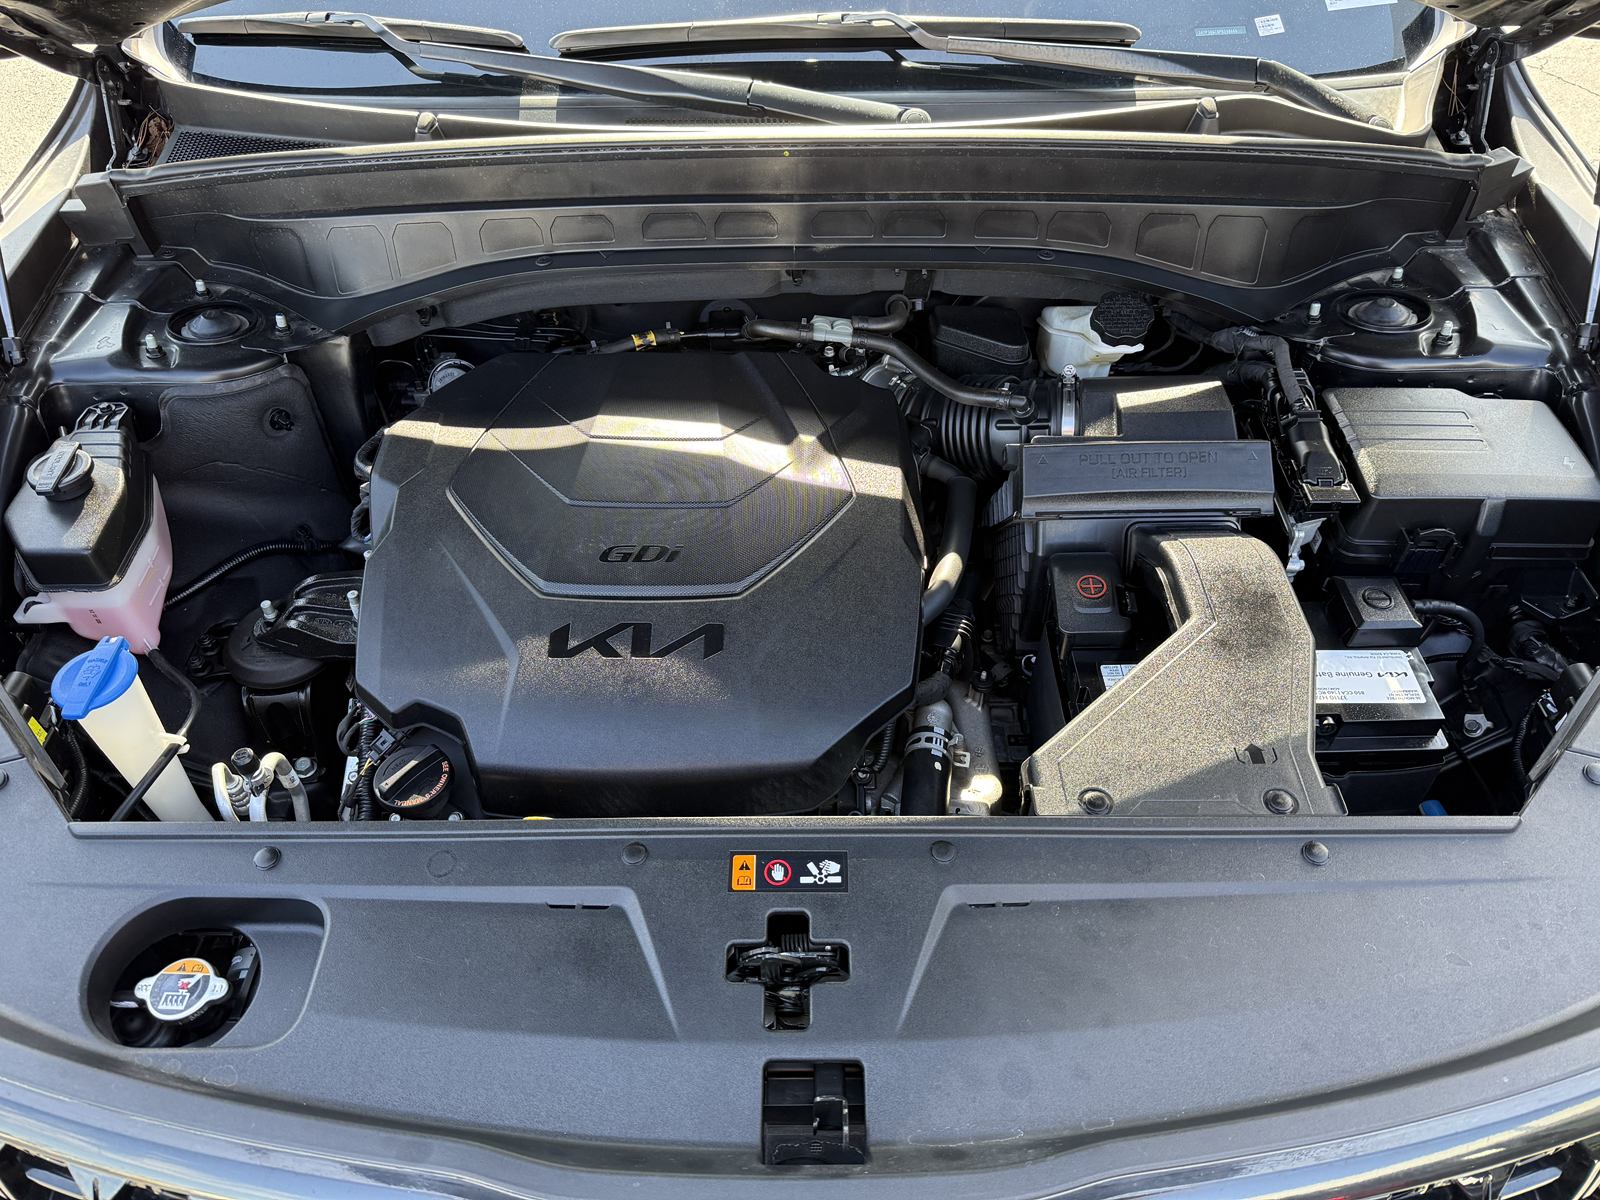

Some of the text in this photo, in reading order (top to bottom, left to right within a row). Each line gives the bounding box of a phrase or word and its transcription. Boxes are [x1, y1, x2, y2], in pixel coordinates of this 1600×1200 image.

[1078, 450, 1218, 466] PULL OUT TO OPEN
[598, 544, 684, 563] GDi
[547, 622, 725, 660] KIA
[441, 760, 450, 772] SEE
[425, 773, 448, 799] OWNER'S
